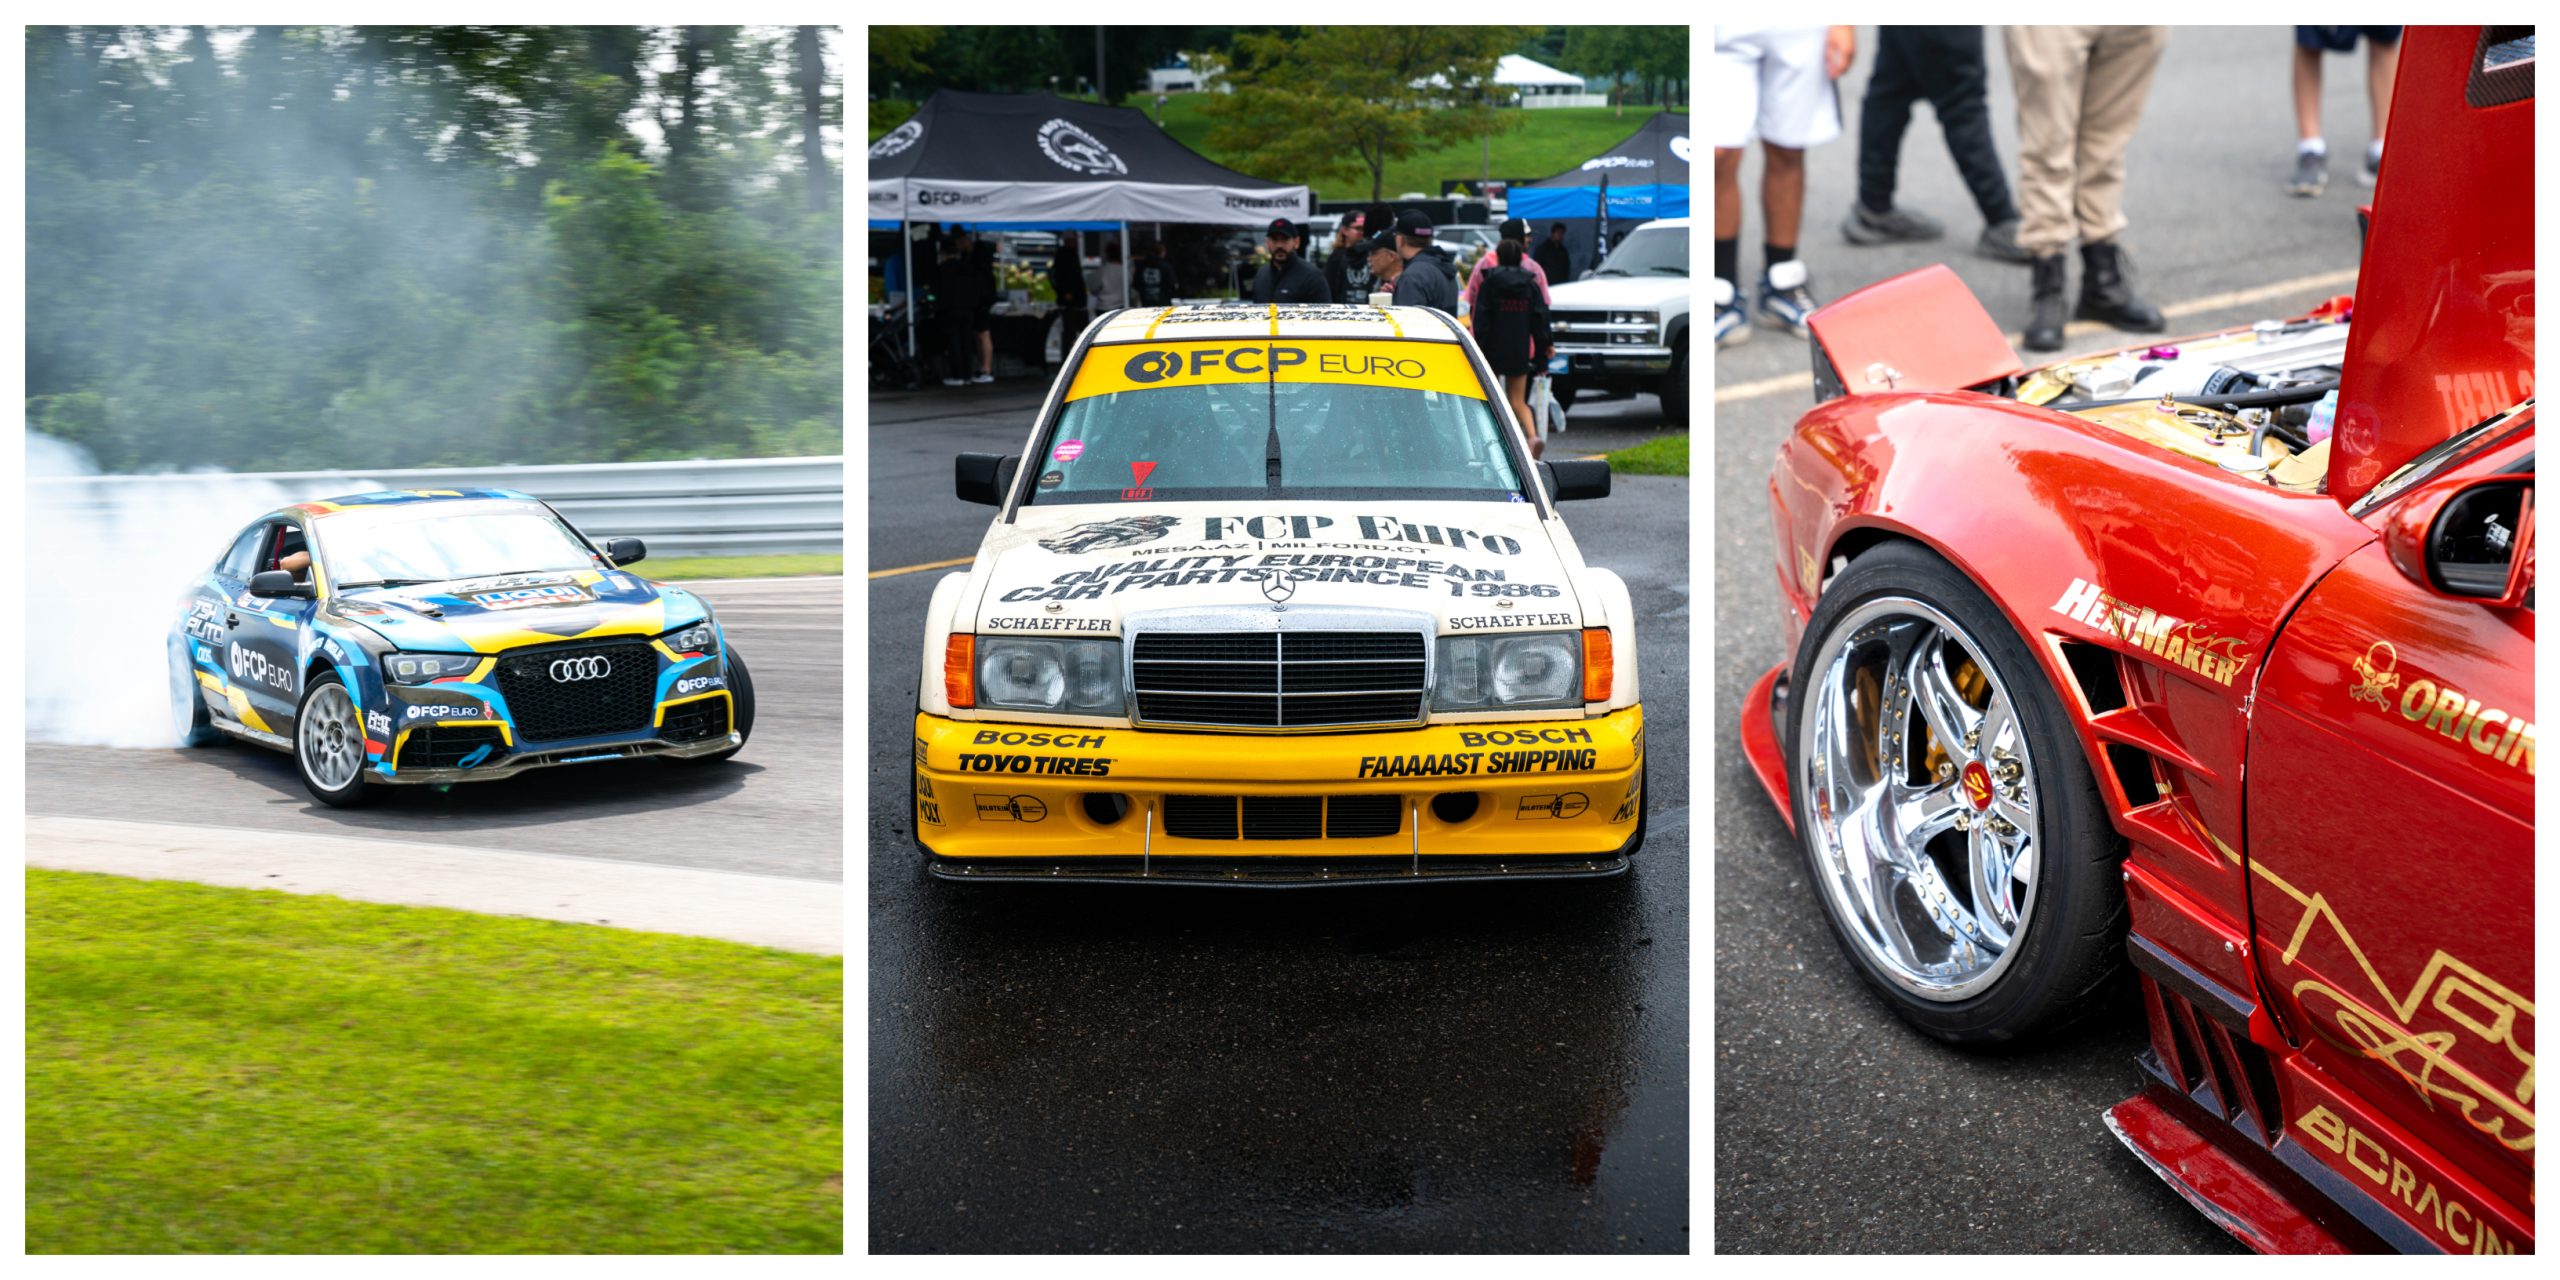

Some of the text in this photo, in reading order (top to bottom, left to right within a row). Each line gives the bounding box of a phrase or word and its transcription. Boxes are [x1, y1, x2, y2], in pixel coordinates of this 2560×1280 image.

[933, 191, 961, 205] FCP
[1190, 346, 1426, 379] FCP EURO
[1204, 515, 1522, 556] FCP Euro
[1050, 553, 1507, 586] QUALITY EUROPEAN
[999, 567, 1561, 603] CAR PARTS SINCE 1986
[185, 616, 225, 644] AUTO
[988, 617, 1112, 632] SCHAEFFLER
[1449, 613, 1574, 631] SCHAEFFLER
[242, 648, 268, 682] FCP
[268, 663, 293, 693] EURO
[689, 676, 708, 690] FCP
[420, 705, 451, 718] FCP
[451, 706, 479, 717] EURO
[972, 730, 1107, 749] BOSCH
[1458, 727, 1593, 748] BOSCH
[1358, 748, 1597, 778] FAAAAAST SHIPPING
[977, 804, 1010, 813] BILSTEIN
